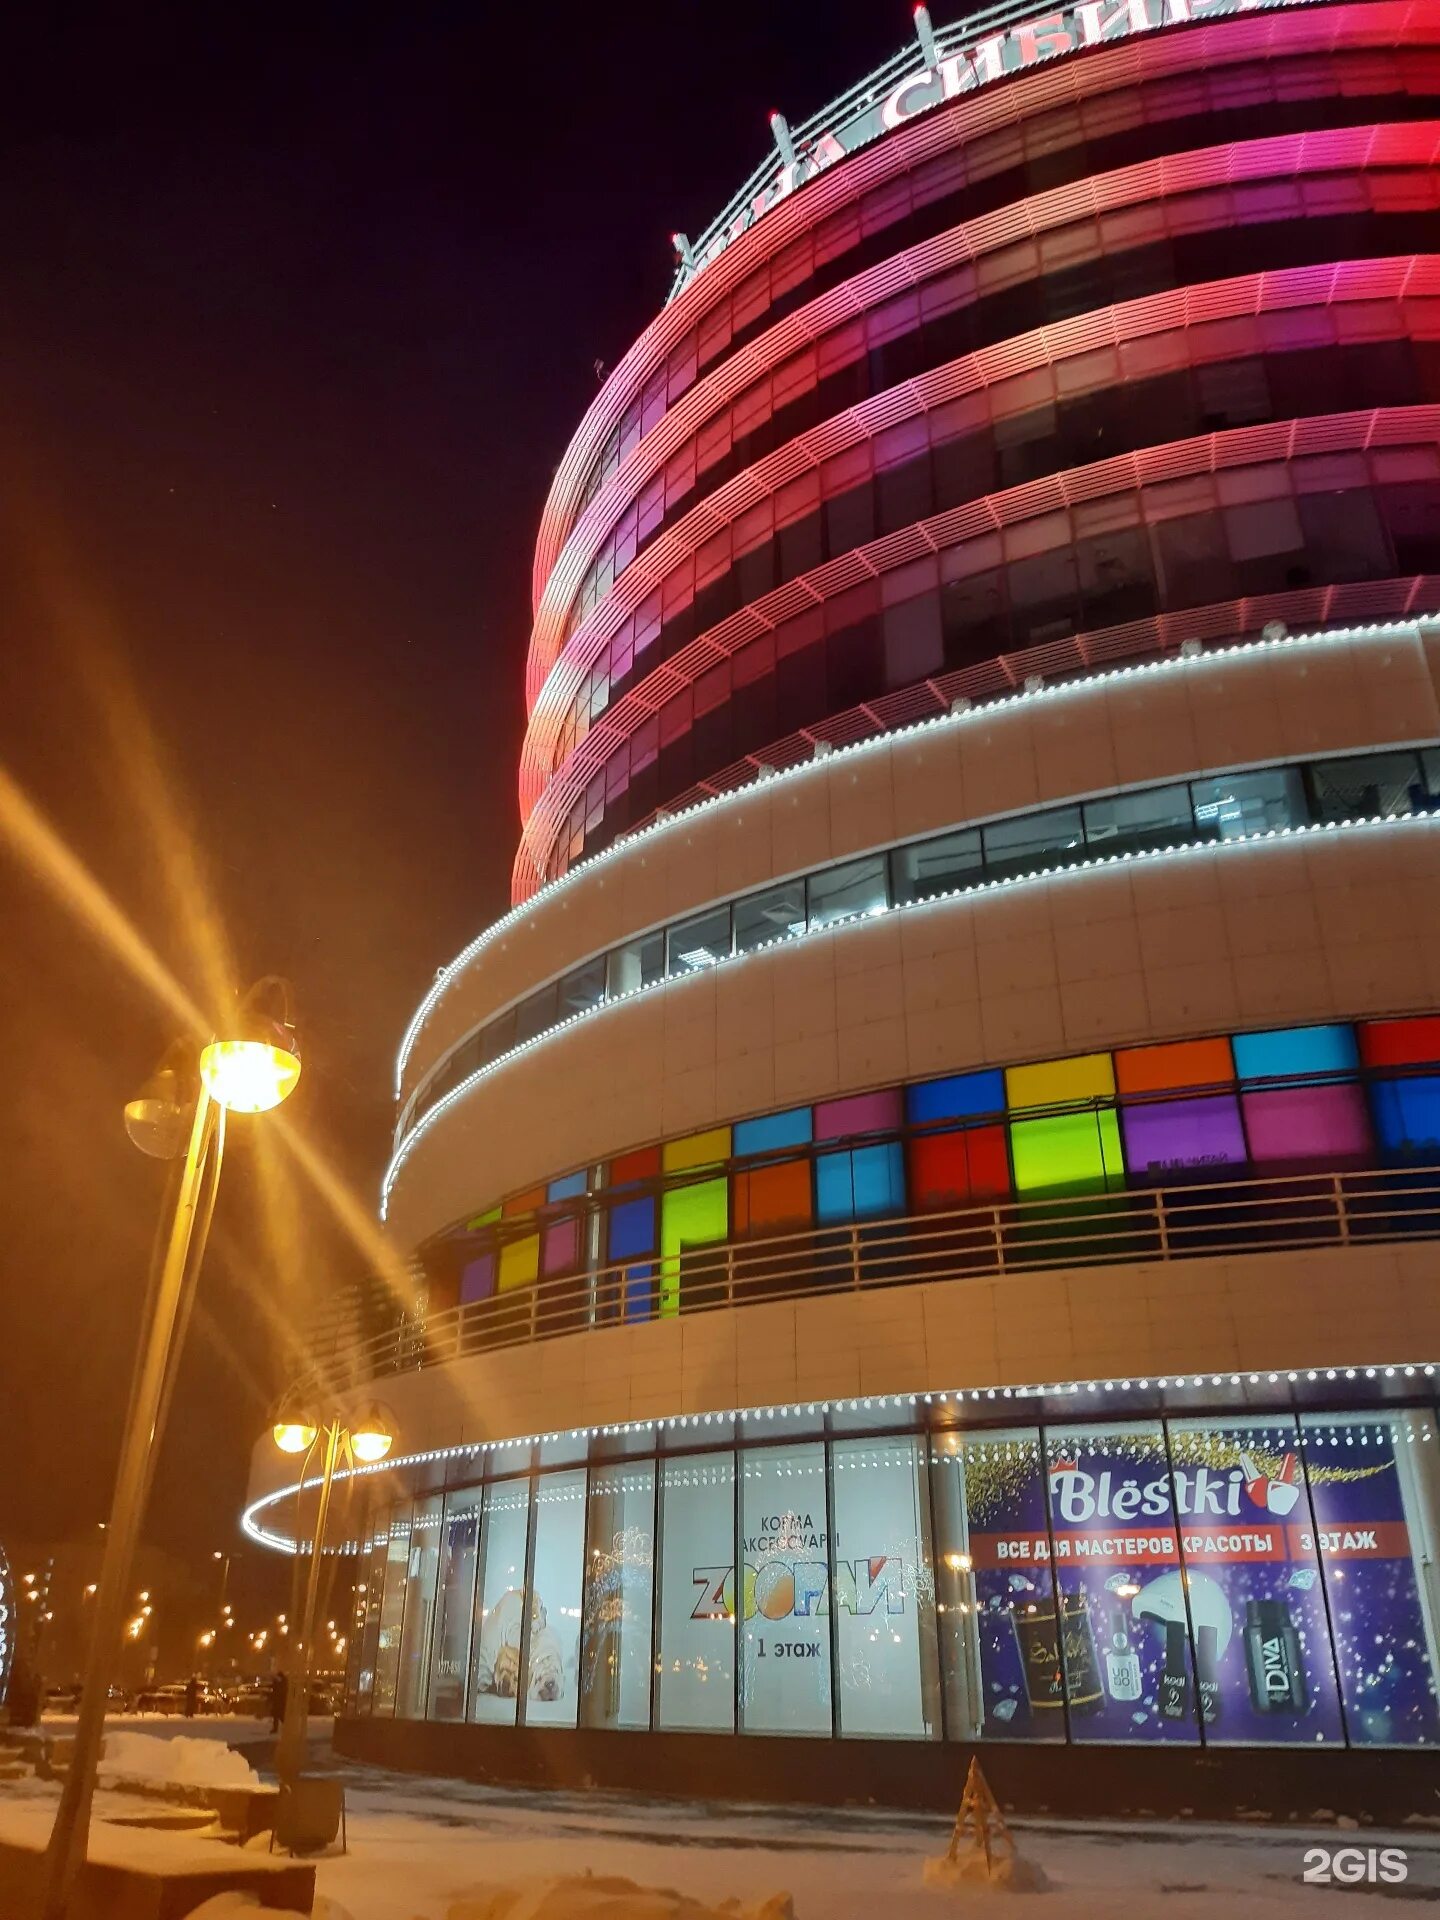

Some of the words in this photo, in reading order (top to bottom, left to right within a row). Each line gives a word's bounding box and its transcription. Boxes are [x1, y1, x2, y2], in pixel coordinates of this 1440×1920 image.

[1050, 1467, 1244, 1523] Blëstki
[997, 1540, 1030, 1559] ВСЕ
[1074, 1537, 1174, 1556] МАСТЕРОВ
[1181, 1534, 1273, 1553] КРАСОТЫ
[1300, 1533, 1313, 1550] 3
[1318, 1531, 1377, 1550] ЭТАЖ
[757, 1638, 766, 1658] 1
[774, 1642, 821, 1658] этаж
[1263, 1637, 1290, 1691] DIVA
